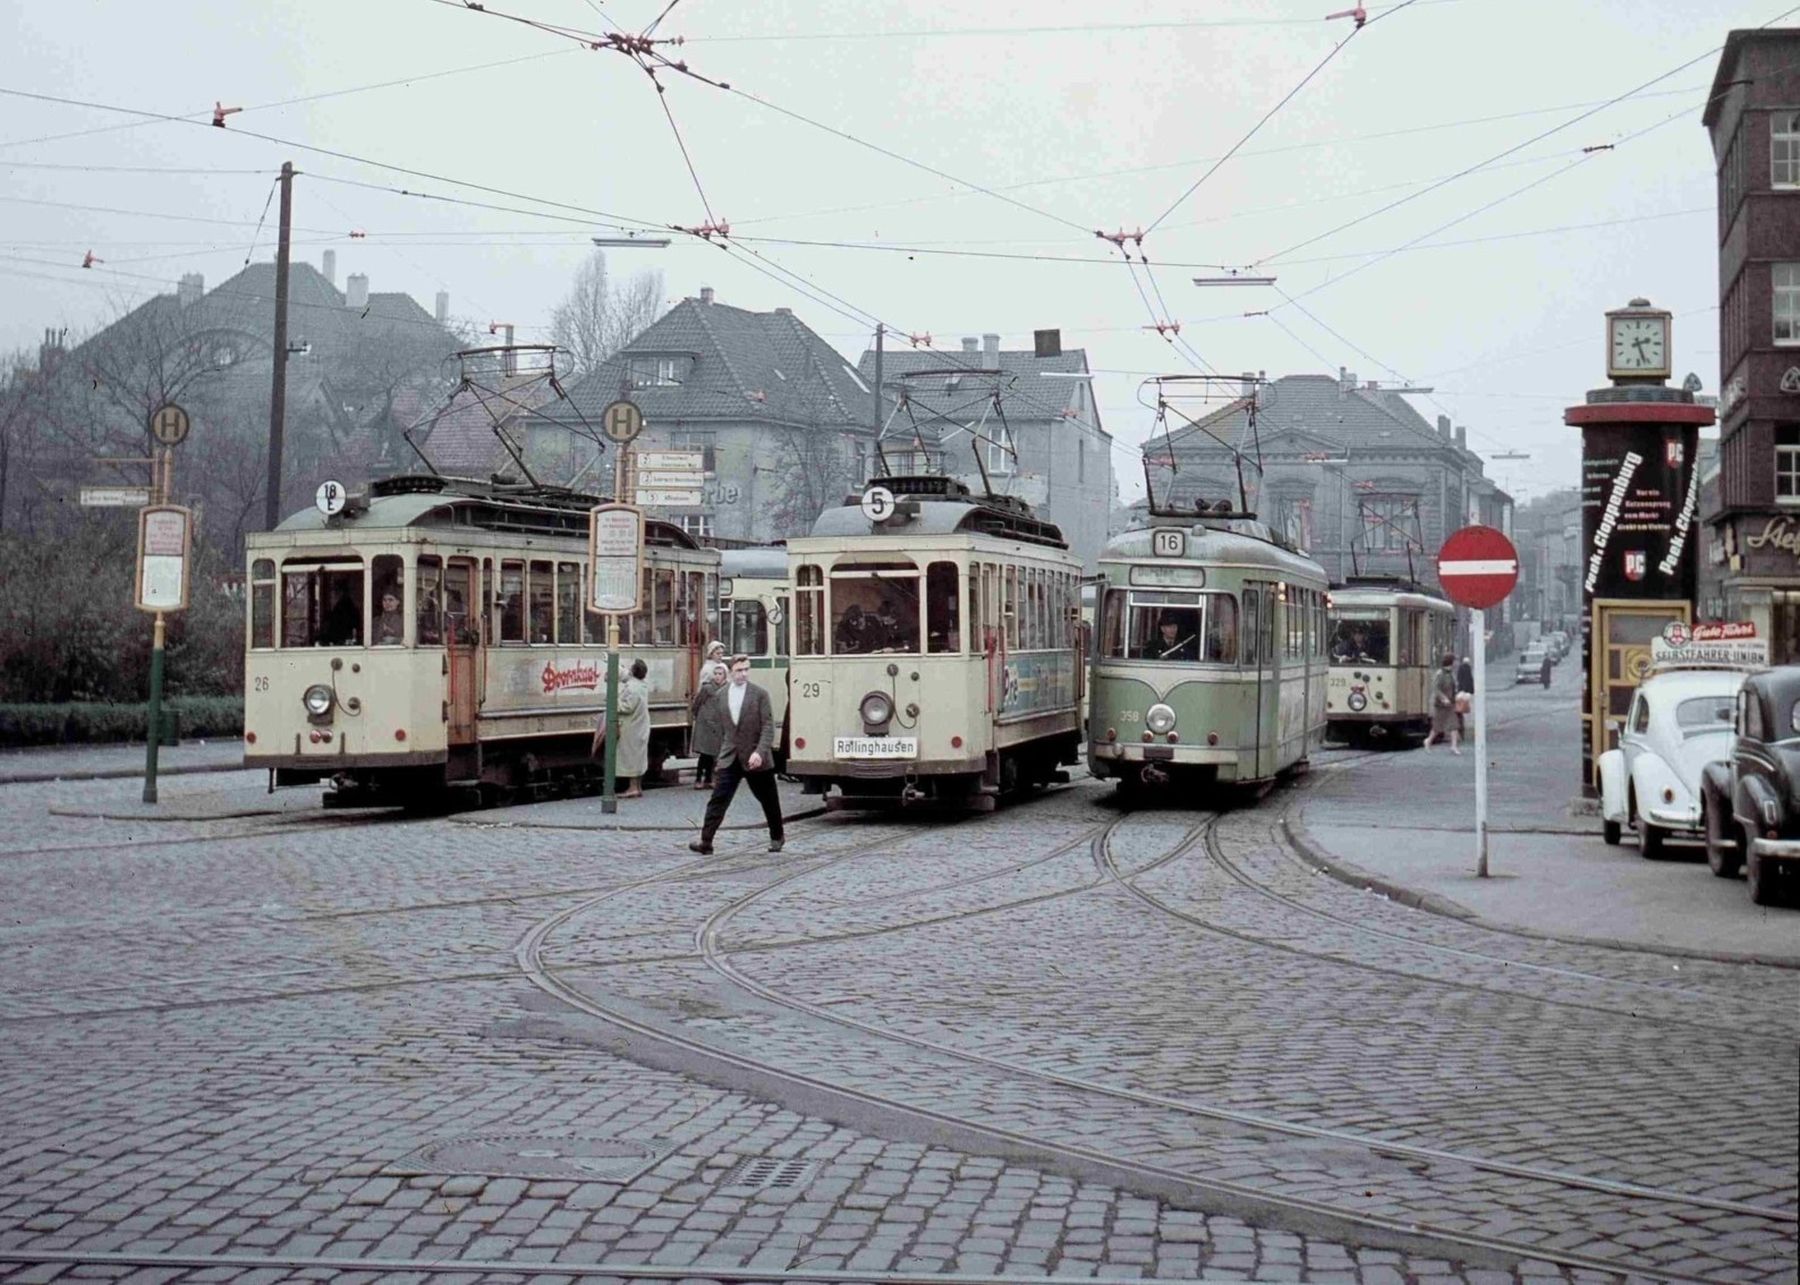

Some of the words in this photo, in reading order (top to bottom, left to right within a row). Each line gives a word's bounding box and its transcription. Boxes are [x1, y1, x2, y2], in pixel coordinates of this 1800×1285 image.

[161, 412, 179, 437] H
[612, 408, 632, 434] H
[324, 484, 337, 499] 18
[1594, 451, 1643, 547] Cloppenburg
[327, 498, 335, 511] E
[871, 491, 885, 514] 5
[1160, 535, 1178, 550] 16
[1625, 554, 1646, 575] PC
[1659, 535, 1684, 575] Peek
[255, 676, 269, 691] 26
[803, 683, 820, 698] 29
